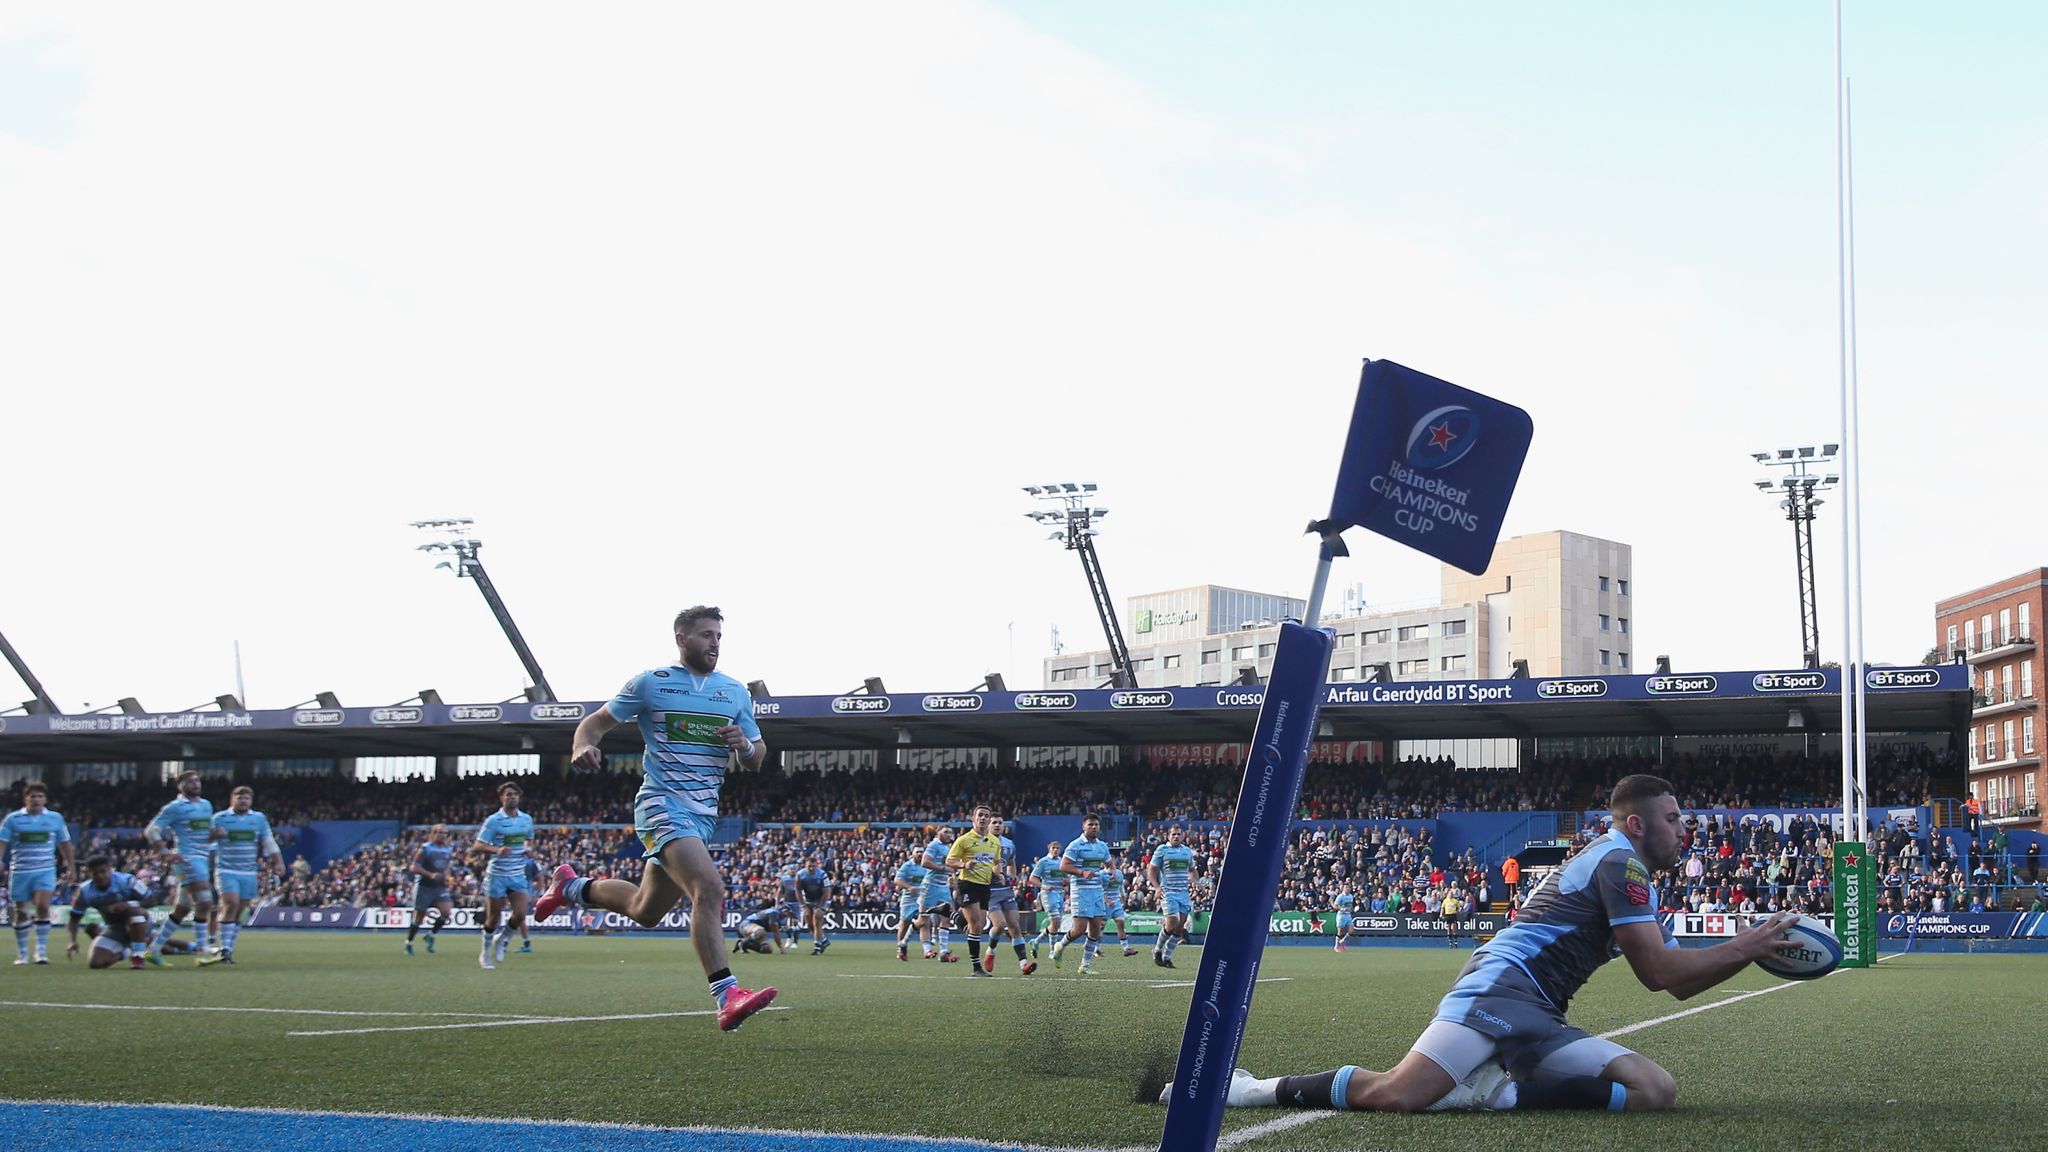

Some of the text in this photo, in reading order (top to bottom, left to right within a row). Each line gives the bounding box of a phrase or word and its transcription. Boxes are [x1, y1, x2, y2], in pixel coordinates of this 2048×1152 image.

[1388, 460, 1468, 506] Heineken
[1369, 475, 1479, 532] CHAMPIONS
[1394, 509, 1435, 535] CUP
[1154, 612, 1184, 626] Holiday
[1654, 678, 1709, 691] BT Sport
[1762, 676, 1818, 688] BT Sport
[1876, 673, 1931, 686] BT Sport
[660, 687, 690, 696] macron
[1216, 684, 1512, 705] Croeso Arfau Caerdydd BT Sport
[1546, 682, 1599, 695] BT Sport
[752, 700, 781, 714] here
[839, 701, 884, 711] BT Sport
[930, 698, 976, 709] BT Sport
[1023, 695, 1069, 707] BT Sport
[1118, 694, 1166, 706] BT Sport
[49, 713, 253, 732] Welcome to BT Sport Cardiff Arms Park
[1699, 743, 1779, 754] HIGH MOTIVE
[1249, 700, 1289, 848] Heineken CHAMPIONS CUP
[842, 912, 901, 931] NEWC
[1355, 919, 1394, 929] BT Sport
[1404, 917, 1429, 931] Take
[1463, 917, 1476, 931] all
[1478, 920, 1493, 931] on
[1843, 873, 1860, 961] Heineken
[1906, 924, 1990, 934] CHAMPIONS CUP
[1776, 945, 1822, 963] BERT
[1475, 1009, 1513, 1033] macron
[1188, 960, 1227, 1099] Heineken CHAMPIONS CUP
